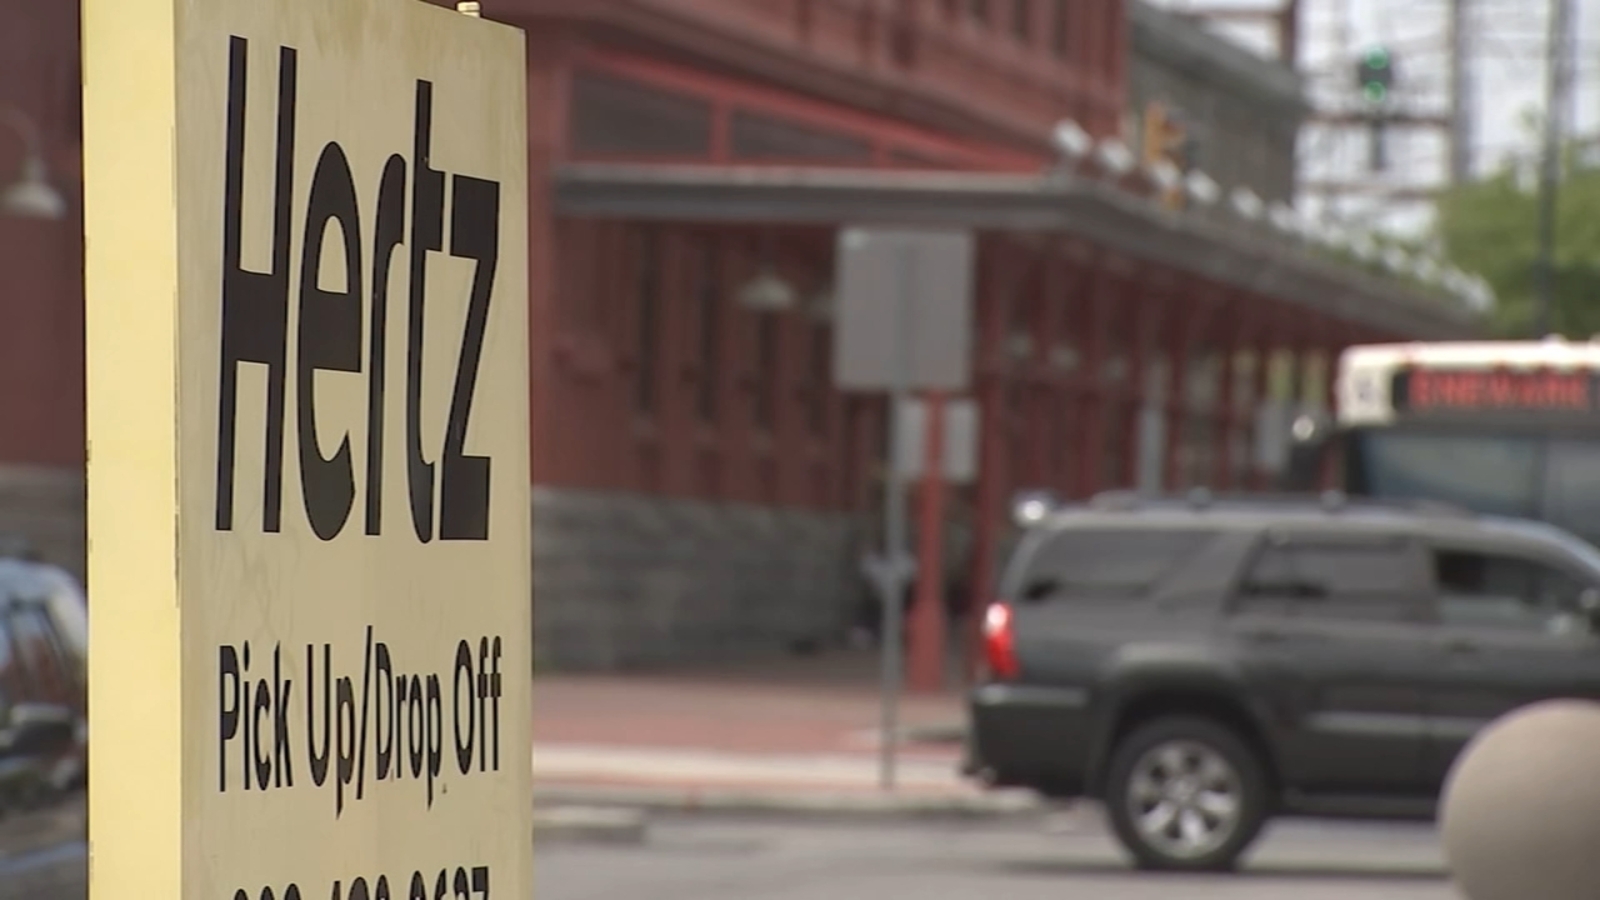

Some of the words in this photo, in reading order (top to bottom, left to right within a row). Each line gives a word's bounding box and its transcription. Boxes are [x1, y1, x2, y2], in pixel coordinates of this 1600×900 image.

[216, 35, 500, 543] Hertz
[219, 639, 293, 792] Pick
[306, 625, 442, 820] Up/Drop
[453, 635, 502, 776] Off
